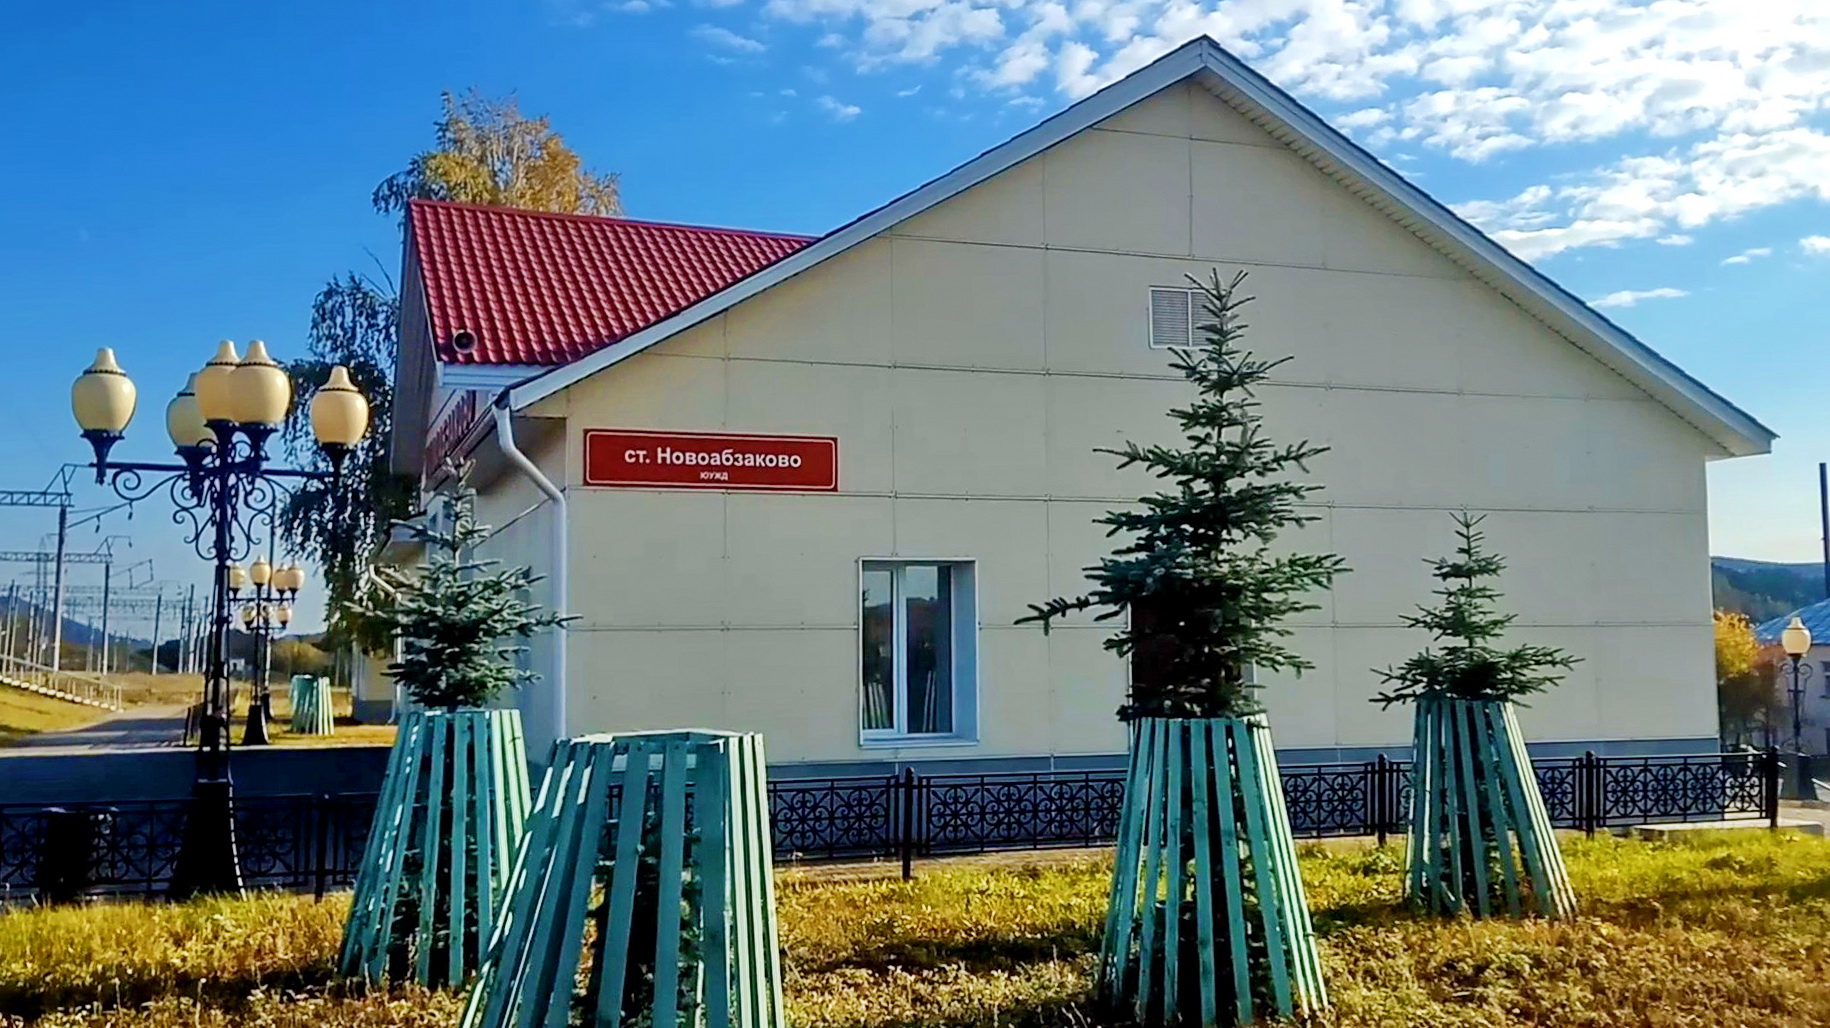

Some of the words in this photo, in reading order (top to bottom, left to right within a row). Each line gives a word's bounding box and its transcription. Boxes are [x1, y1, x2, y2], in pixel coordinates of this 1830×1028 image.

[624, 449, 650, 464] ст.
[656, 446, 802, 468] Новоабзаково
[699, 471, 729, 482] ЮУЖД
